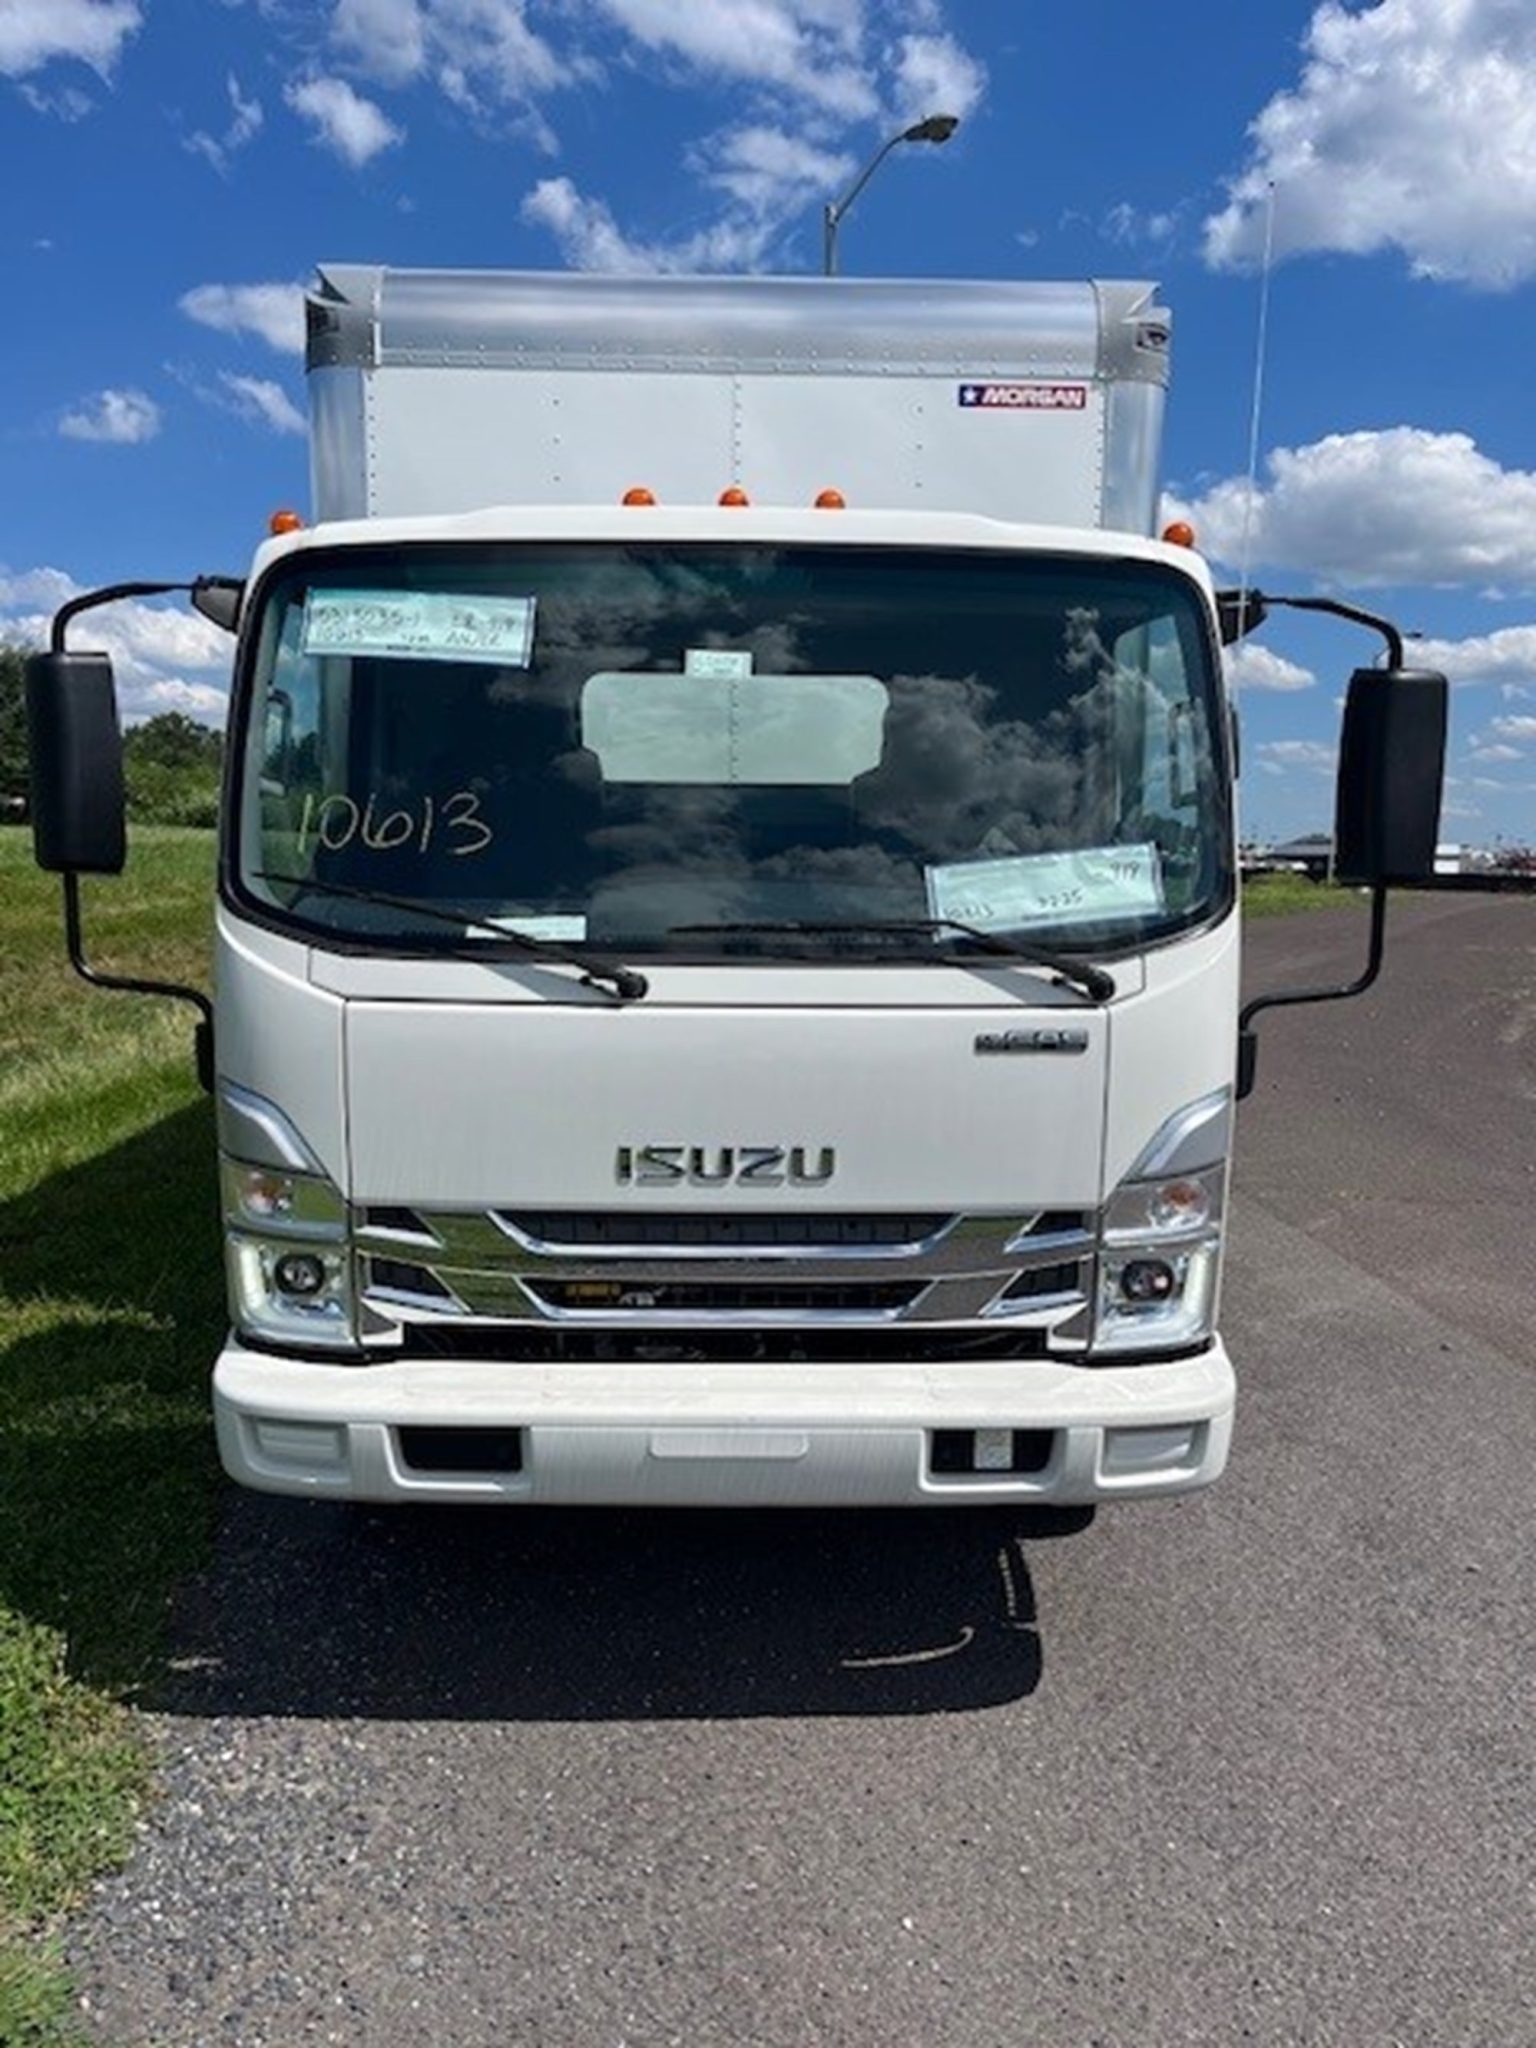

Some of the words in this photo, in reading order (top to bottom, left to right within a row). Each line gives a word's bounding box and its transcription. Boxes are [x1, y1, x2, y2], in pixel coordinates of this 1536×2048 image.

[981, 386, 1083, 407] MORGAN
[297, 792, 493, 855] 10613
[615, 1146, 835, 1188] ISUZU
